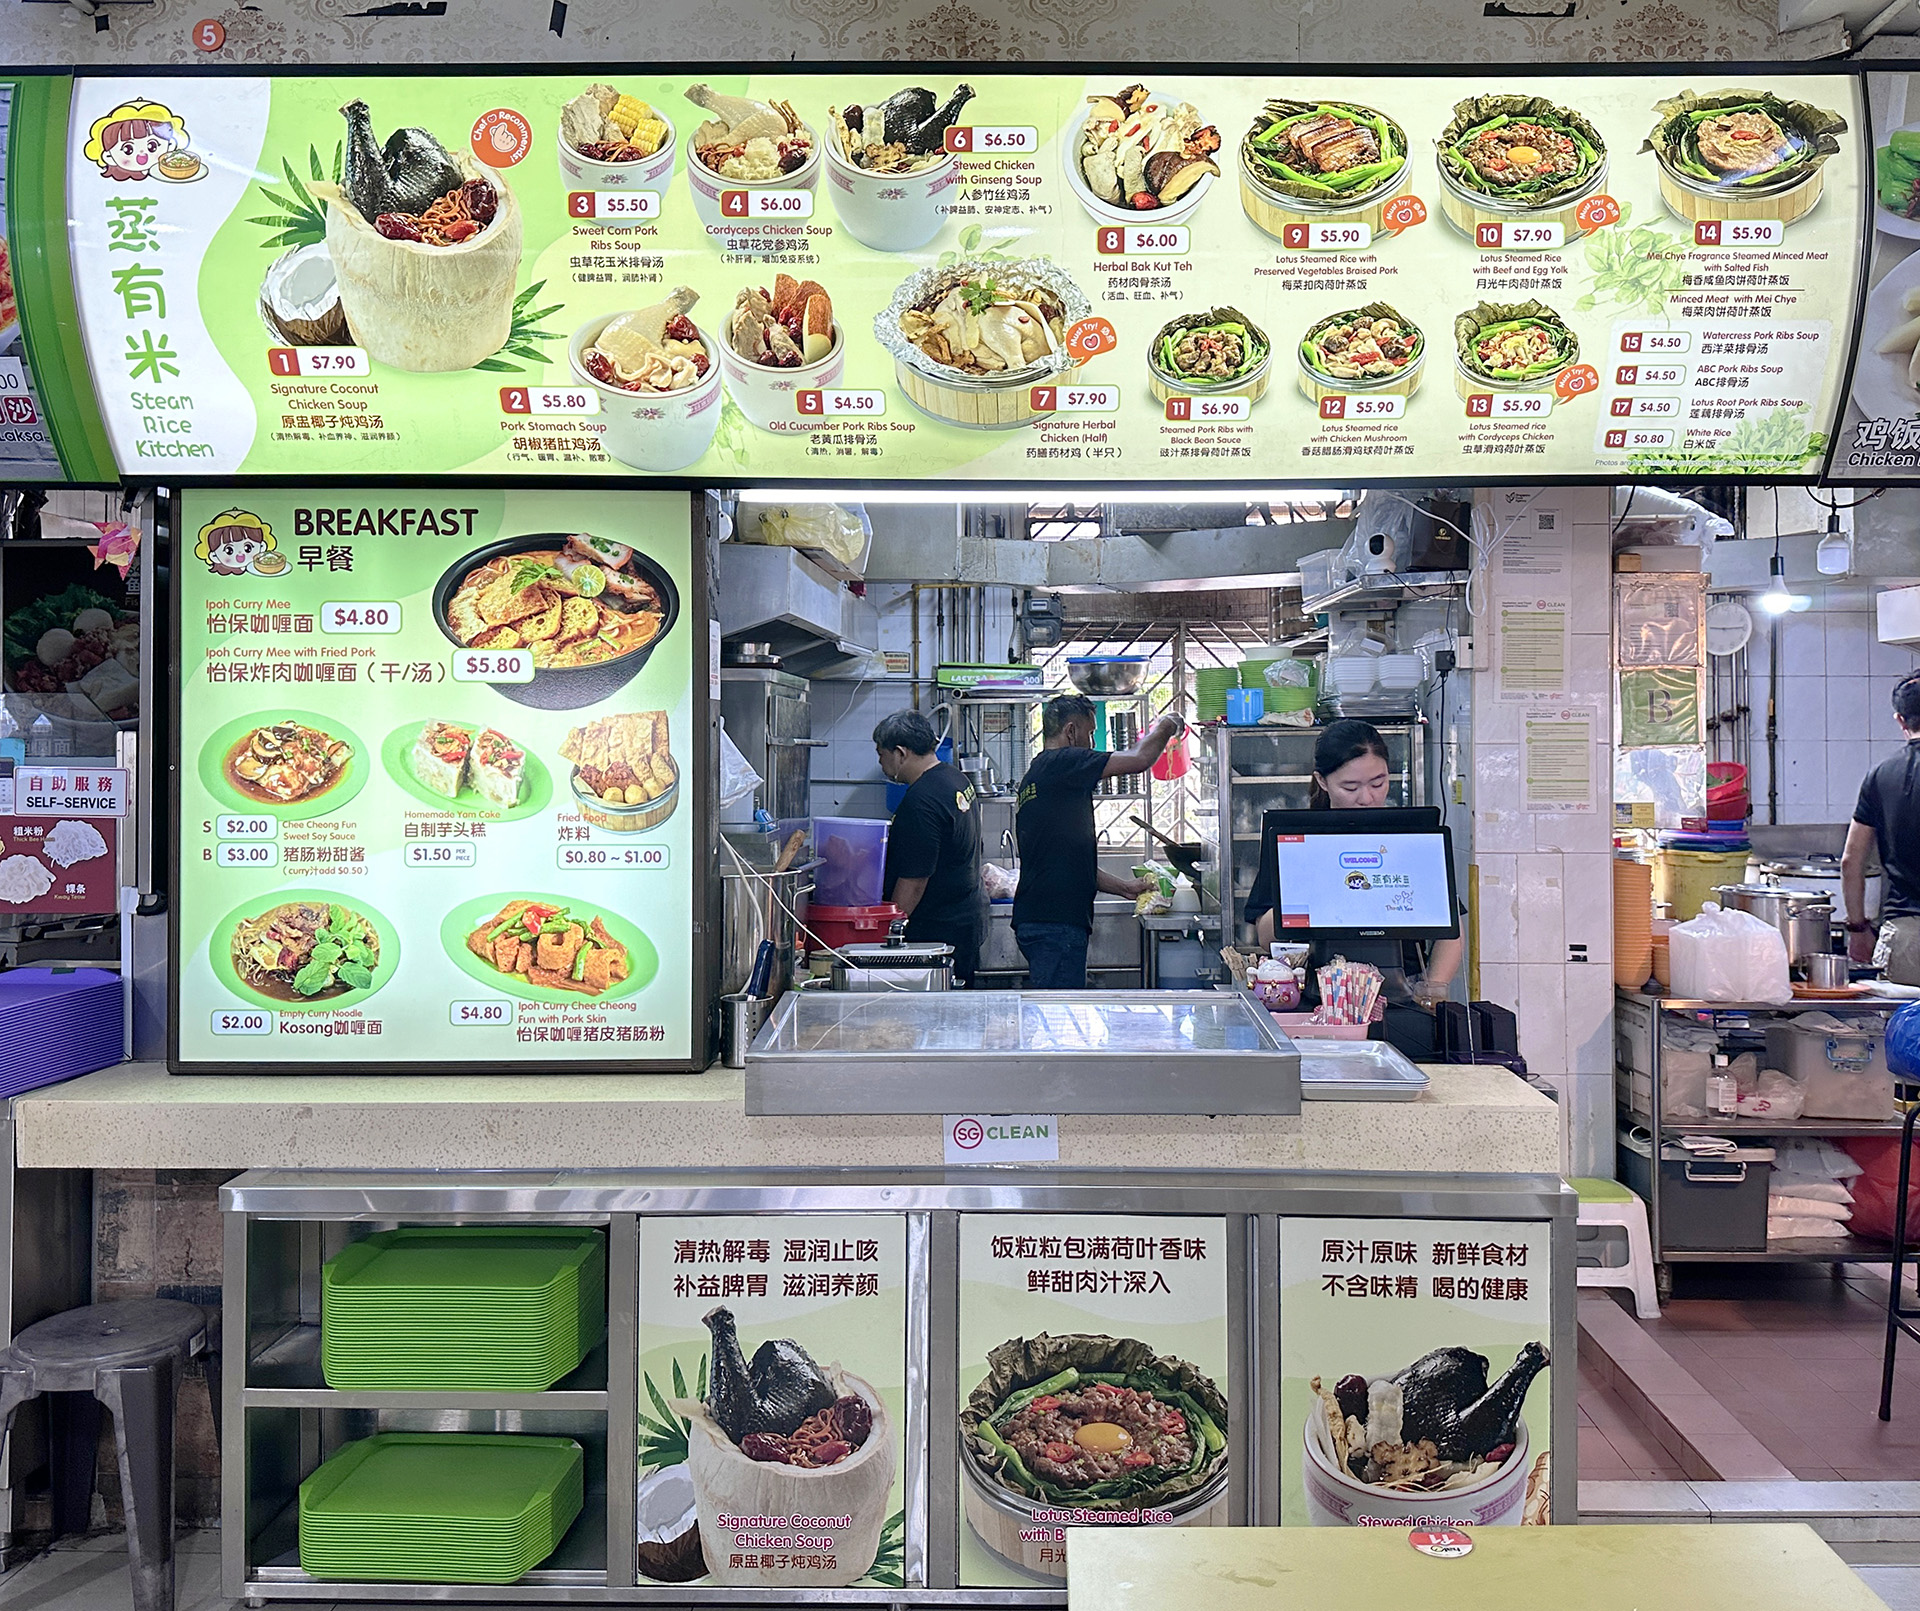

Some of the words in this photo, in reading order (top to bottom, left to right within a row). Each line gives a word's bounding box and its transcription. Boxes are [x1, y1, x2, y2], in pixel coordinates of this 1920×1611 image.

[201, 25, 216, 45] 5
[952, 160, 991, 171] Stewed
[994, 160, 1034, 169] Chicken
[572, 225, 606, 236] Sweet
[607, 225, 632, 236] Corn
[635, 225, 659, 236] Pork
[591, 240, 611, 249] Ribs
[615, 241, 641, 252] Soup
[727, 239, 809, 251] 虫草花党参鸡汤
[1104, 231, 1118, 249] 8
[1137, 234, 1177, 247] $6.00
[570, 257, 663, 268] 虫草花玉米排骨汤
[1505, 254, 1542, 262] Steamed
[1545, 254, 1561, 262] Rice
[1094, 262, 1128, 271] Herbal
[1132, 262, 1150, 271] Bak
[1154, 262, 1171, 271] Kut
[1174, 261, 1192, 271] Teh
[106, 196, 180, 384] 蒸有米
[1624, 336, 1639, 349] 15
[1651, 338, 1680, 347] $4.50
[1620, 369, 1634, 382] 16
[1646, 371, 1675, 380] $4.50
[1695, 377, 1749, 387] ABC排骨汤
[271, 384, 327, 396] Signature
[330, 384, 378, 393] Coconut
[131, 392, 193, 409] Steam
[804, 393, 816, 411] 5
[835, 397, 873, 409] $4.50
[1037, 390, 1050, 407] 7
[1069, 393, 1106, 405] $7.90
[1614, 401, 1629, 414] 17
[1640, 403, 1670, 412] $4.50
[143, 416, 191, 433] Rice
[501, 421, 525, 430] Pork
[528, 422, 576, 431] Stomach
[579, 422, 606, 434] Soup
[769, 421, 787, 431] Old
[789, 421, 839, 431] Cucumber
[843, 421, 864, 431] Pork
[867, 421, 888, 431] Ribs
[890, 421, 916, 433] Soup
[1032, 420, 1079, 431] Signature
[1083, 420, 1115, 429] Herbal
[513, 437, 600, 451] 胡椒猪肚鸡汤
[811, 434, 877, 445] 老黄瓜排骨汤
[1478, 433, 1520, 442] Cordyceps
[136, 440, 214, 457] Kitchen
[1848, 452, 1914, 467] Chicken
[295, 508, 478, 536] BREAKFAST
[297, 545, 353, 572] 早餐
[206, 599, 230, 611] Ipoh
[234, 599, 263, 611] Curry
[266, 599, 290, 609] Mee
[207, 613, 313, 634] 怡保咖喱面
[335, 608, 388, 626] $4.80
[206, 647, 230, 659] Ipoh
[234, 648, 263, 659] Curry
[266, 648, 290, 657] Mee
[294, 647, 317, 656] with
[321, 647, 347, 657] Fried
[351, 647, 375, 657] Pork
[467, 657, 520, 674] $5.80
[1024, 676, 1040, 684] 300
[1647, 690, 1673, 724] B
[31, 776, 112, 792] 自助服務
[27, 797, 116, 809] SELF-SERVICE
[405, 810, 455, 818] Homemade
[557, 813, 580, 822] Fried
[583, 813, 607, 822] Food
[203, 821, 211, 833] S
[227, 820, 267, 833] $2.00
[282, 821, 305, 829] Chee
[307, 821, 339, 831] Cheong
[405, 822, 486, 837] 自制芋头糕
[558, 826, 590, 841] 炸料
[204, 849, 212, 860] B
[228, 848, 268, 861] $3.00
[284, 847, 364, 862] 猪肠粉甜酱
[414, 848, 451, 861] $1.50
[279, 1009, 305, 1020] Empty
[307, 1009, 330, 1020] Curry
[332, 1009, 363, 1018] Noodle
[461, 1006, 502, 1019] $4.80
[519, 1015, 535, 1023] Fun
[539, 1015, 559, 1023] with
[562, 1014, 583, 1023] Pork
[587, 1014, 606, 1023] Skin
[222, 1016, 262, 1029] $2.00
[517, 1026, 665, 1042] 怡保咖喱猪皮猪肠粉
[957, 1127, 980, 1141] SG
[986, 1125, 1049, 1139] CLEAN
[674, 1239, 770, 1263] 清热解毒
[784, 1239, 878, 1262] 湿润止咳
[991, 1235, 1206, 1260] 饭粒粒包满荷叶香味
[1321, 1240, 1417, 1264] 原汁原味
[1432, 1242, 1529, 1266] 新鲜食材
[674, 1274, 767, 1297] 补益脾胃
[783, 1273, 878, 1297] 滋润养颜
[1028, 1268, 1170, 1293] 鲜甜肉汁深入
[1322, 1274, 1418, 1298] 不含味精
[1433, 1277, 1528, 1300] 喝的健康
[717, 1514, 787, 1530] Signature
[791, 1514, 852, 1529] Coconut
[1031, 1509, 1070, 1523] Lotus
[1073, 1509, 1138, 1523] Steamed
[1142, 1510, 1174, 1523] Rice
[1020, 1527, 1050, 1541] with
[734, 1534, 792, 1549] Chicken
[795, 1534, 833, 1551] Soup
[729, 1552, 836, 1569] 原盅椰子炖鸡汤
